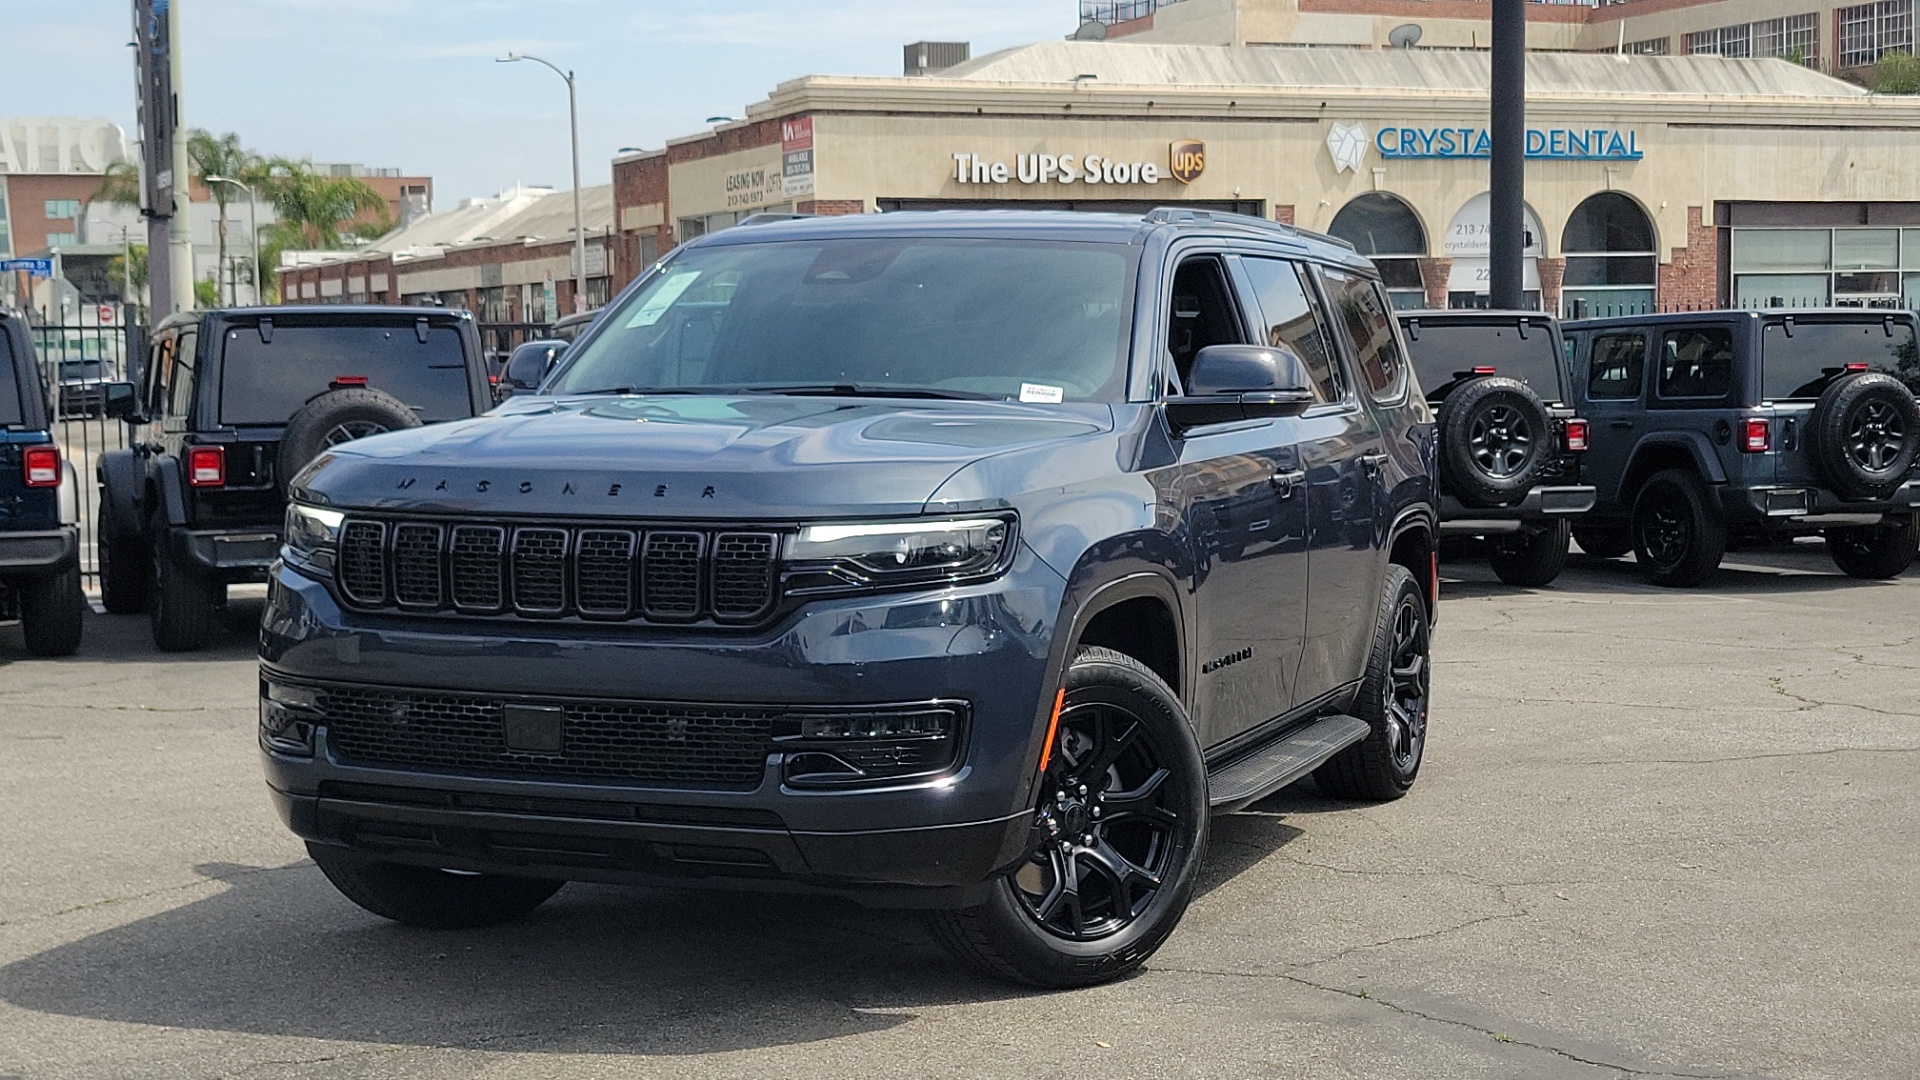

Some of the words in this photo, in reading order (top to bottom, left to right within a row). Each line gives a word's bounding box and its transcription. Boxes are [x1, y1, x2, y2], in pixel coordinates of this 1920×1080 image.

[1376, 127, 1491, 155] CRYSTA
[1525, 129, 1643, 156] DENTAL
[726, 172, 750, 192] LEASING
[751, 171, 765, 189] NOW
[953, 153, 1008, 184] The
[1017, 153, 1075, 184] UPS
[1084, 154, 1159, 184] Store
